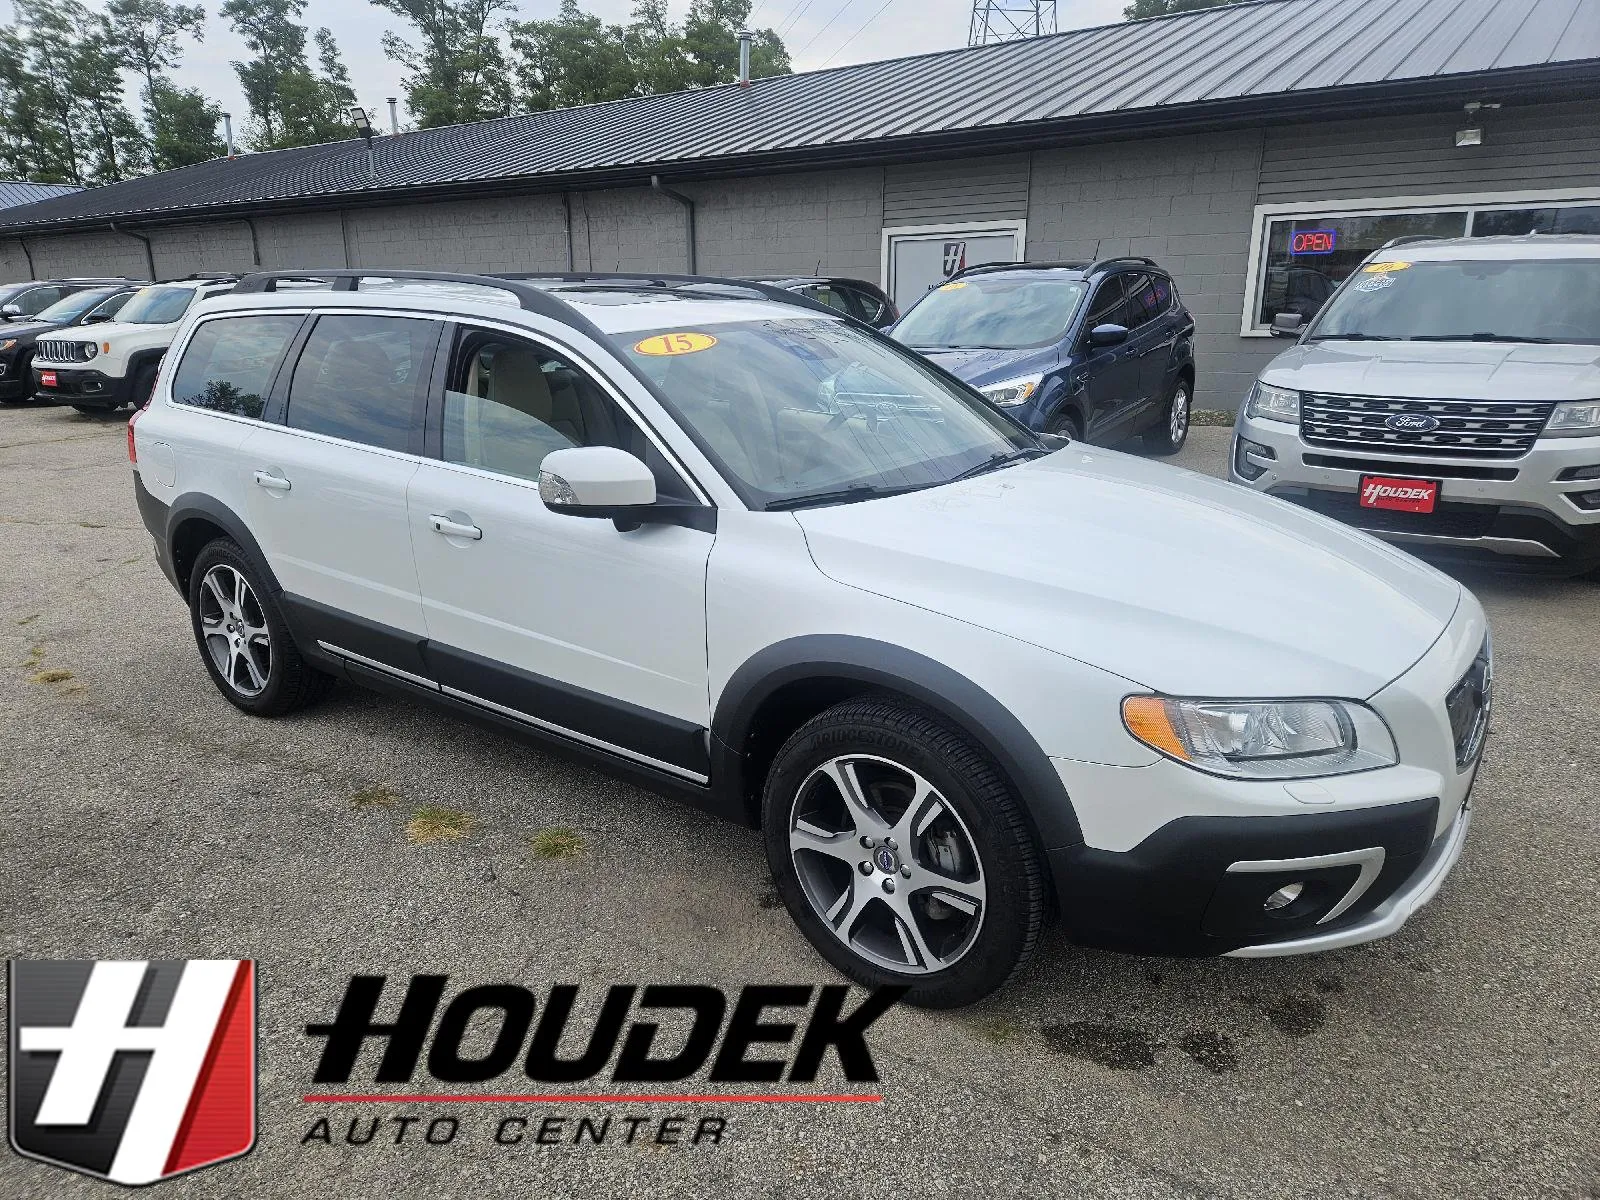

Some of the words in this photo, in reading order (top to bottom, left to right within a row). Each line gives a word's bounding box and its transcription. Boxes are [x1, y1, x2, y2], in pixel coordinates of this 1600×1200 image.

[1293, 233, 1333, 252] OPEN
[662, 334, 693, 353] 15
[1395, 415, 1427, 428] Ford
[1363, 483, 1434, 504] HOUDEK
